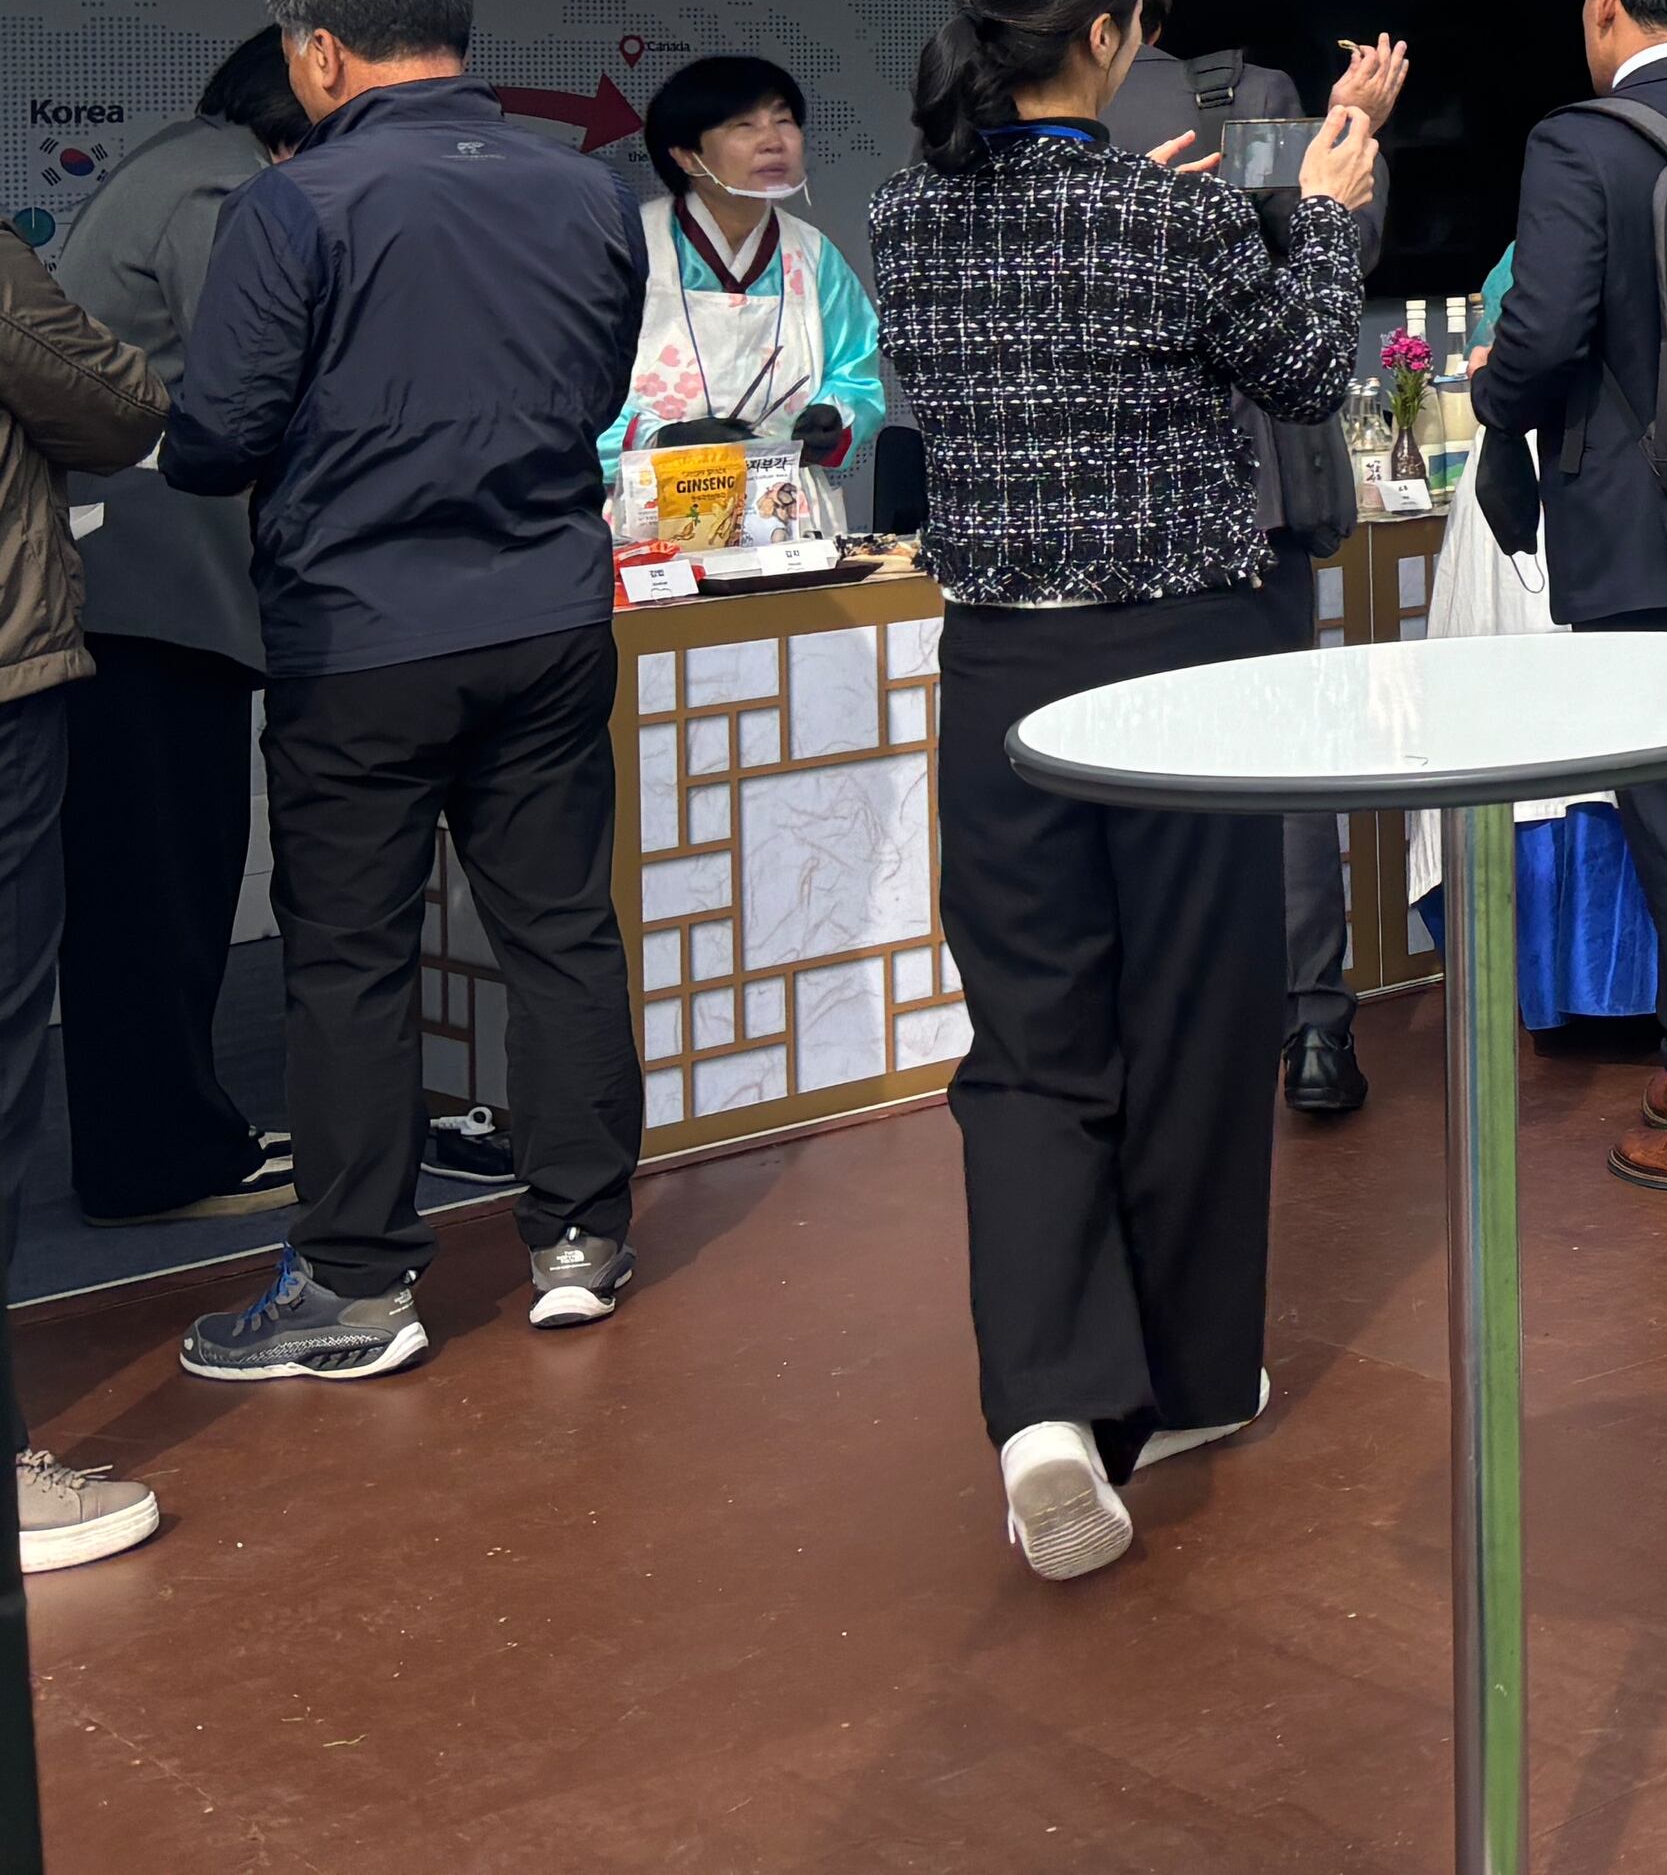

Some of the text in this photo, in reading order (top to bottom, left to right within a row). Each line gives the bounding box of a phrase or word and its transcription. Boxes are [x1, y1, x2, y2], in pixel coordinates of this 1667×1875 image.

[648, 41, 691, 53] Canada
[30, 99, 124, 124] Korea
[746, 456, 788, 471] 지부각
[676, 475, 735, 493] GINSENG
